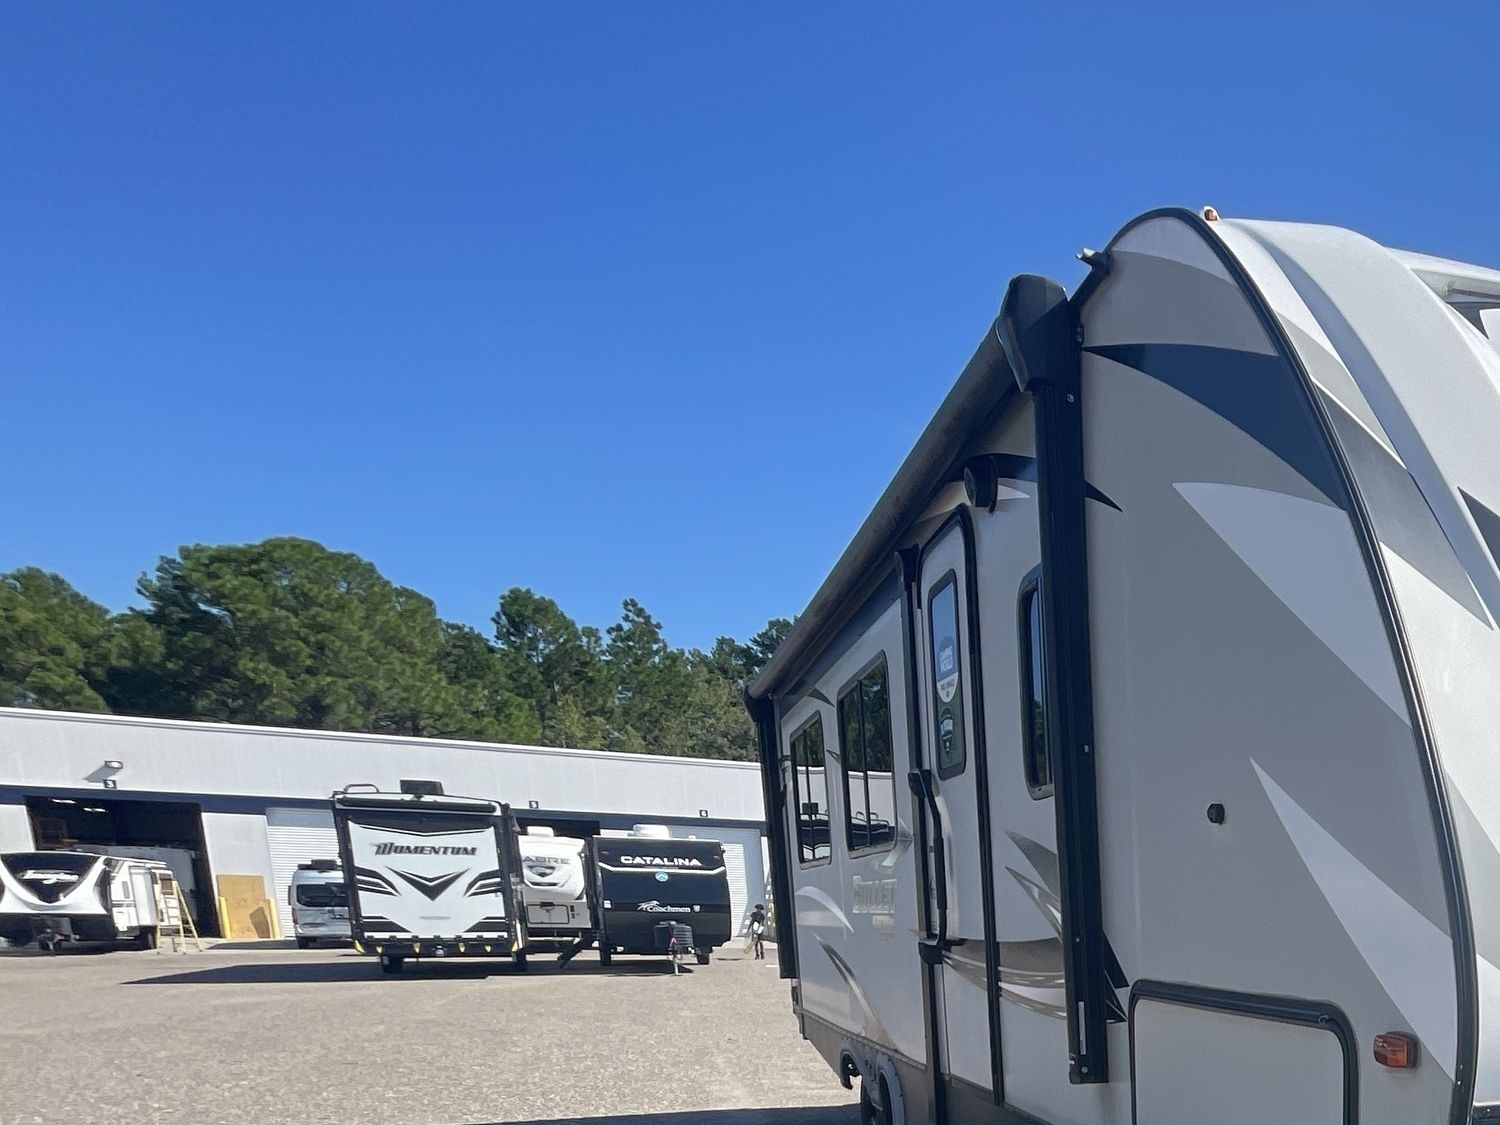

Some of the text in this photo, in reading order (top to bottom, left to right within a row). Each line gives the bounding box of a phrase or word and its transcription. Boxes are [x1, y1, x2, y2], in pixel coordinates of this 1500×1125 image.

[523, 856, 571, 865] ABRE
[620, 855, 702, 866] CATALINA
[647, 905, 691, 913] Coachmen
